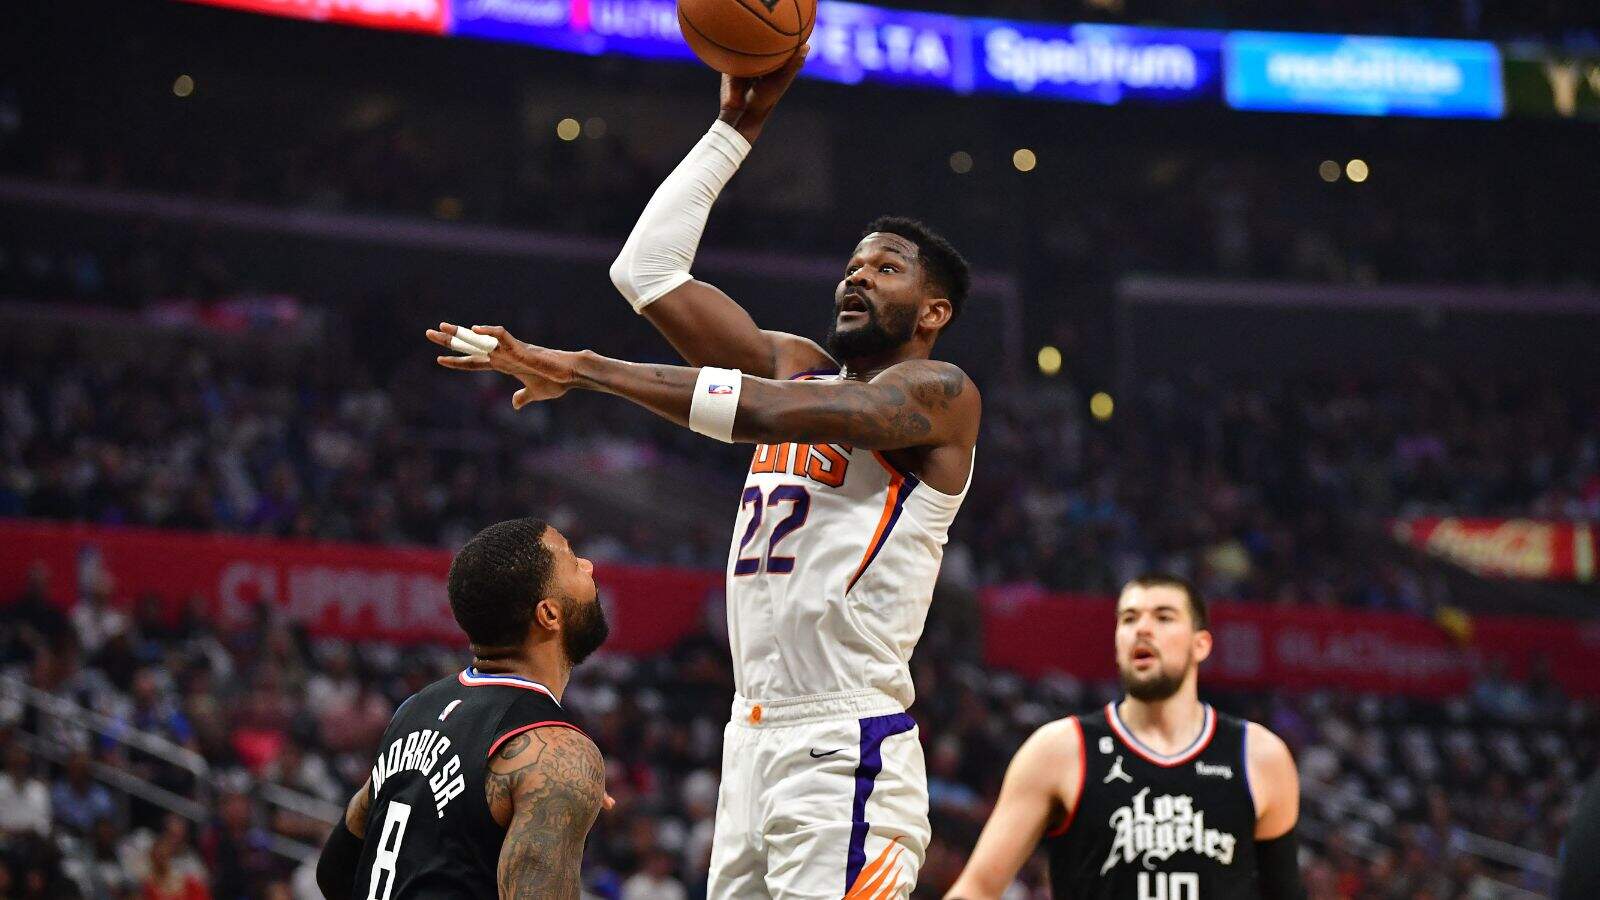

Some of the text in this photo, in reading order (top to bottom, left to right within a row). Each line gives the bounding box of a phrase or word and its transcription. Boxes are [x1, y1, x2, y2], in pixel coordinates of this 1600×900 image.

[984, 27, 1197, 92] Spectrum
[734, 484, 811, 576] 22
[370, 729, 466, 819] MORRIS SR.
[1098, 736, 1115, 754] 6
[1132, 786, 1194, 824] Los
[366, 800, 412, 900] 8
[1100, 810, 1237, 877] Angeles
